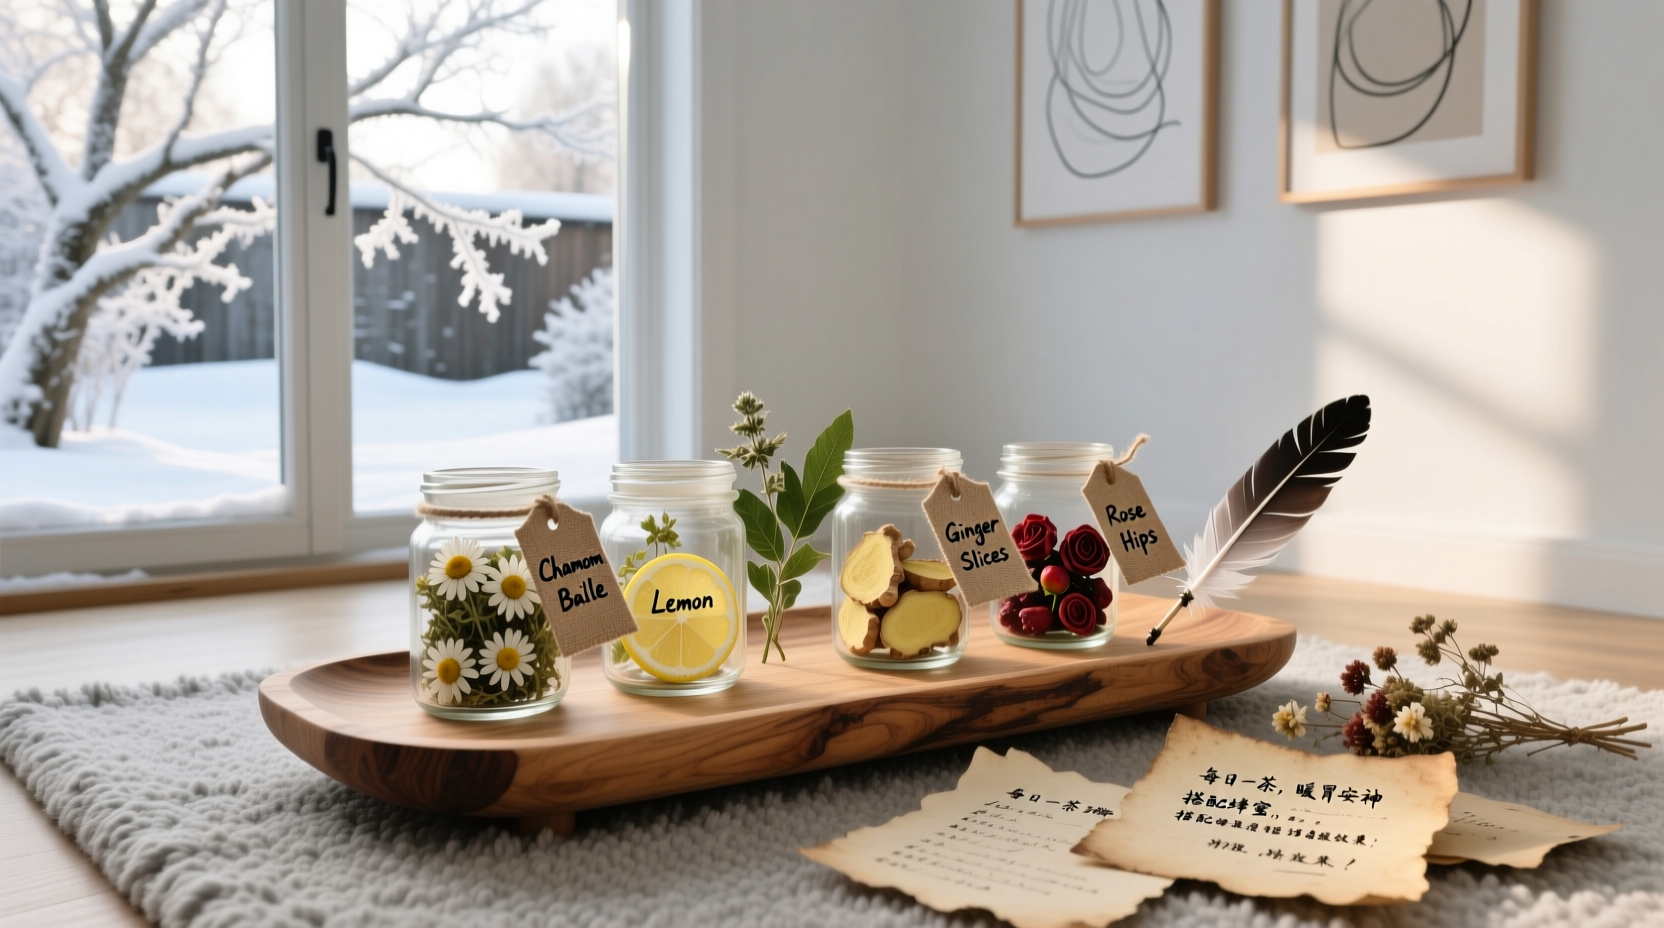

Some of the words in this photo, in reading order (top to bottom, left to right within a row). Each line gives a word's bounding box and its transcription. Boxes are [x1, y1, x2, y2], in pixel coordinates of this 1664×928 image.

[1105, 504, 1147, 526] Rose
[945, 518, 1000, 546] Ginger
[1119, 528, 1158, 555] Hips
[538, 552, 605, 583] Chamom
[960, 546, 1010, 572] Slices
[651, 588, 714, 615] Lemon
